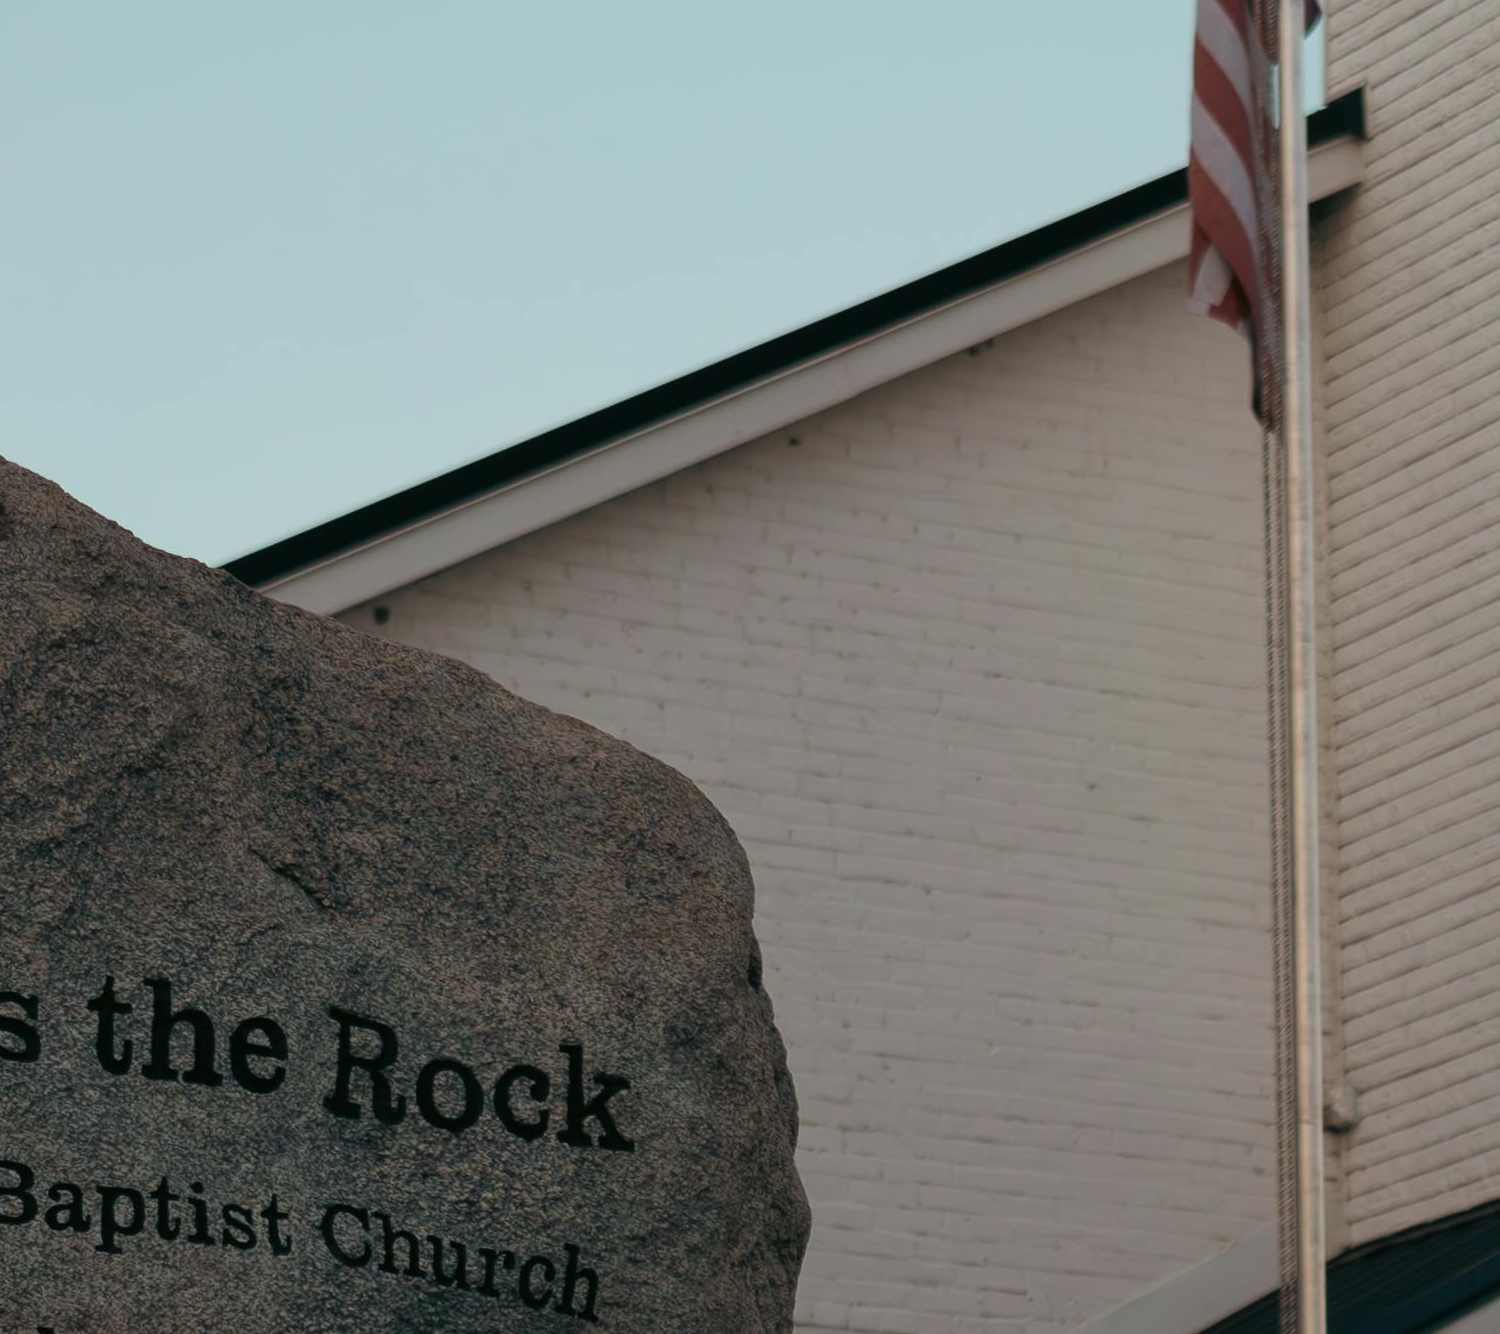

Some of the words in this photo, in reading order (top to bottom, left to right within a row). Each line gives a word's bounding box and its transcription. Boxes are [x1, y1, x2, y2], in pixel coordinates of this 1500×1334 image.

[86, 975, 290, 1096] the
[321, 1004, 636, 1154] Rock
[317, 1201, 602, 1326] Church
